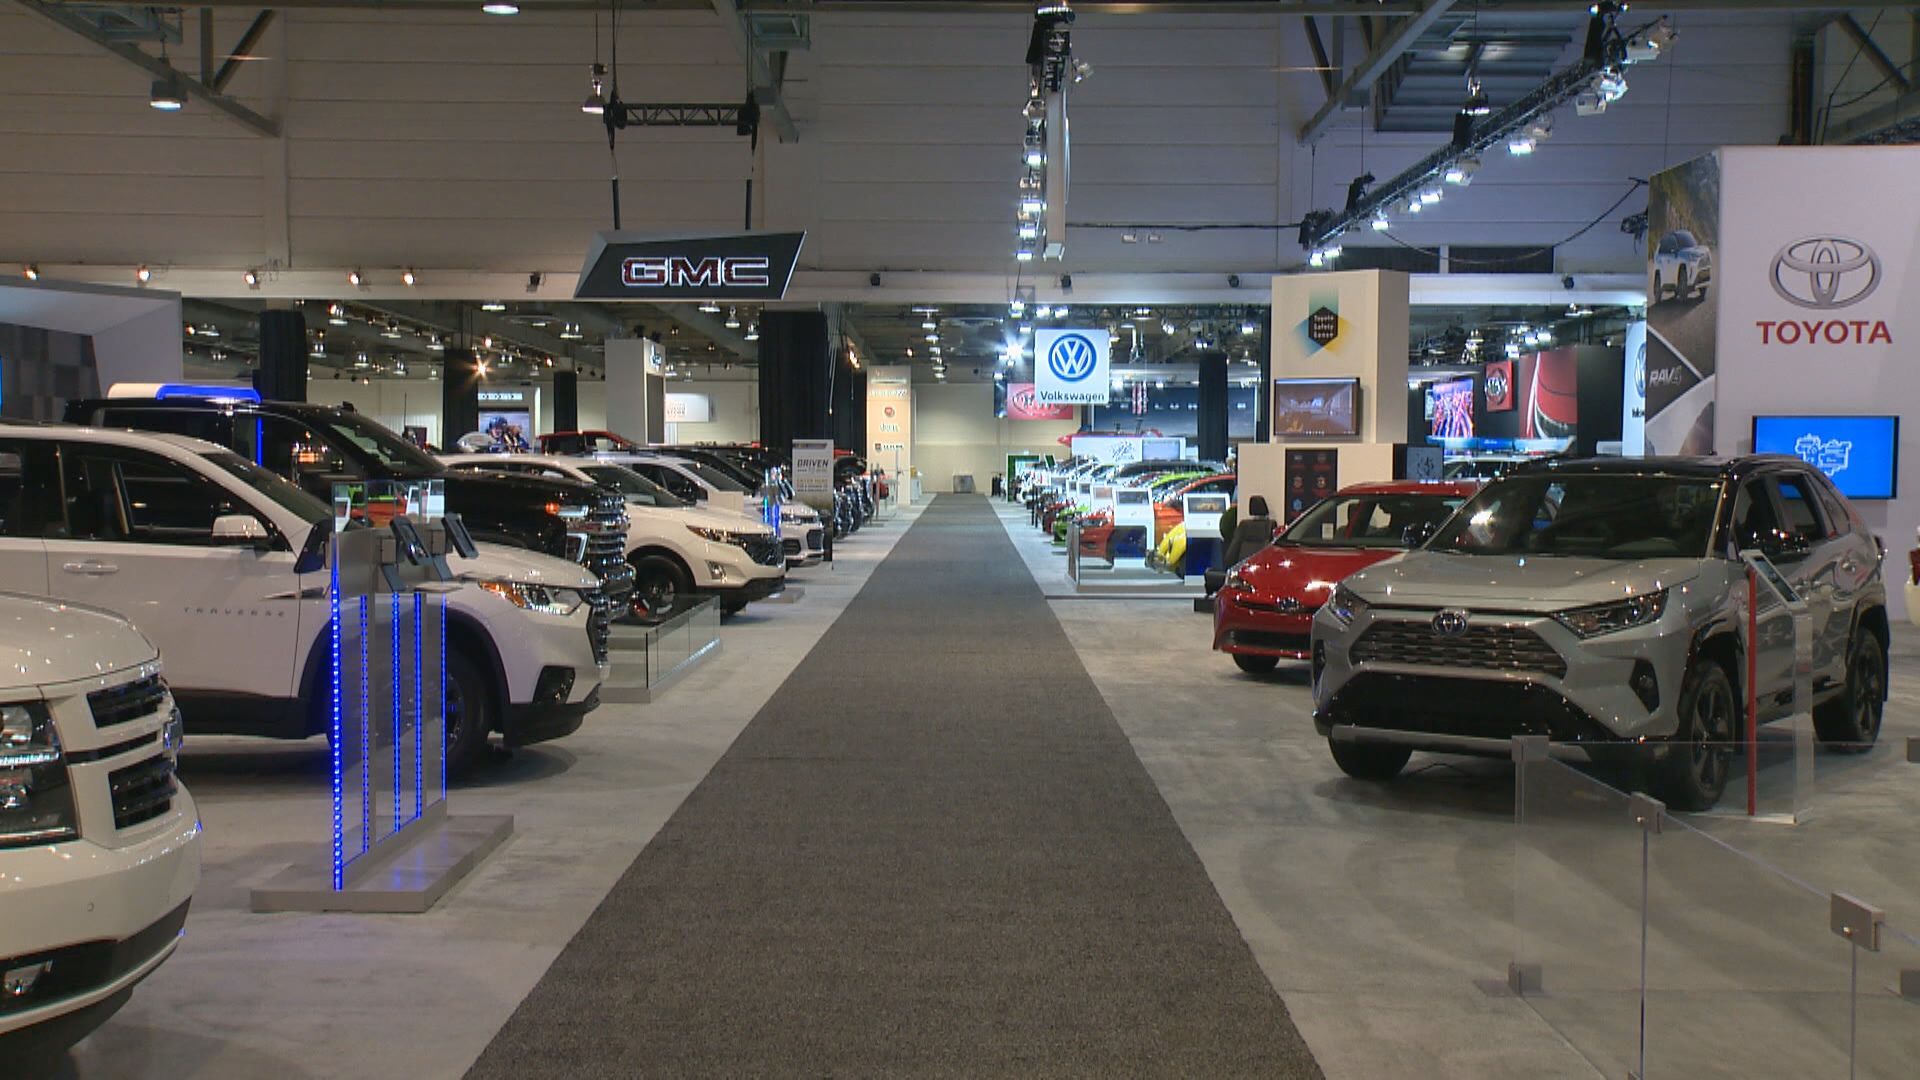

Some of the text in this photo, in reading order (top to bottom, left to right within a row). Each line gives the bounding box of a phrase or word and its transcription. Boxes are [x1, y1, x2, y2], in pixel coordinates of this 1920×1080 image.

[621, 256, 769, 287] GMC
[1755, 319, 1893, 345] TOYOTA
[1040, 390, 1105, 403] Volkswagen
[797, 459, 830, 468] DRIVEN
[184, 606, 285, 617] TRAVERSE
